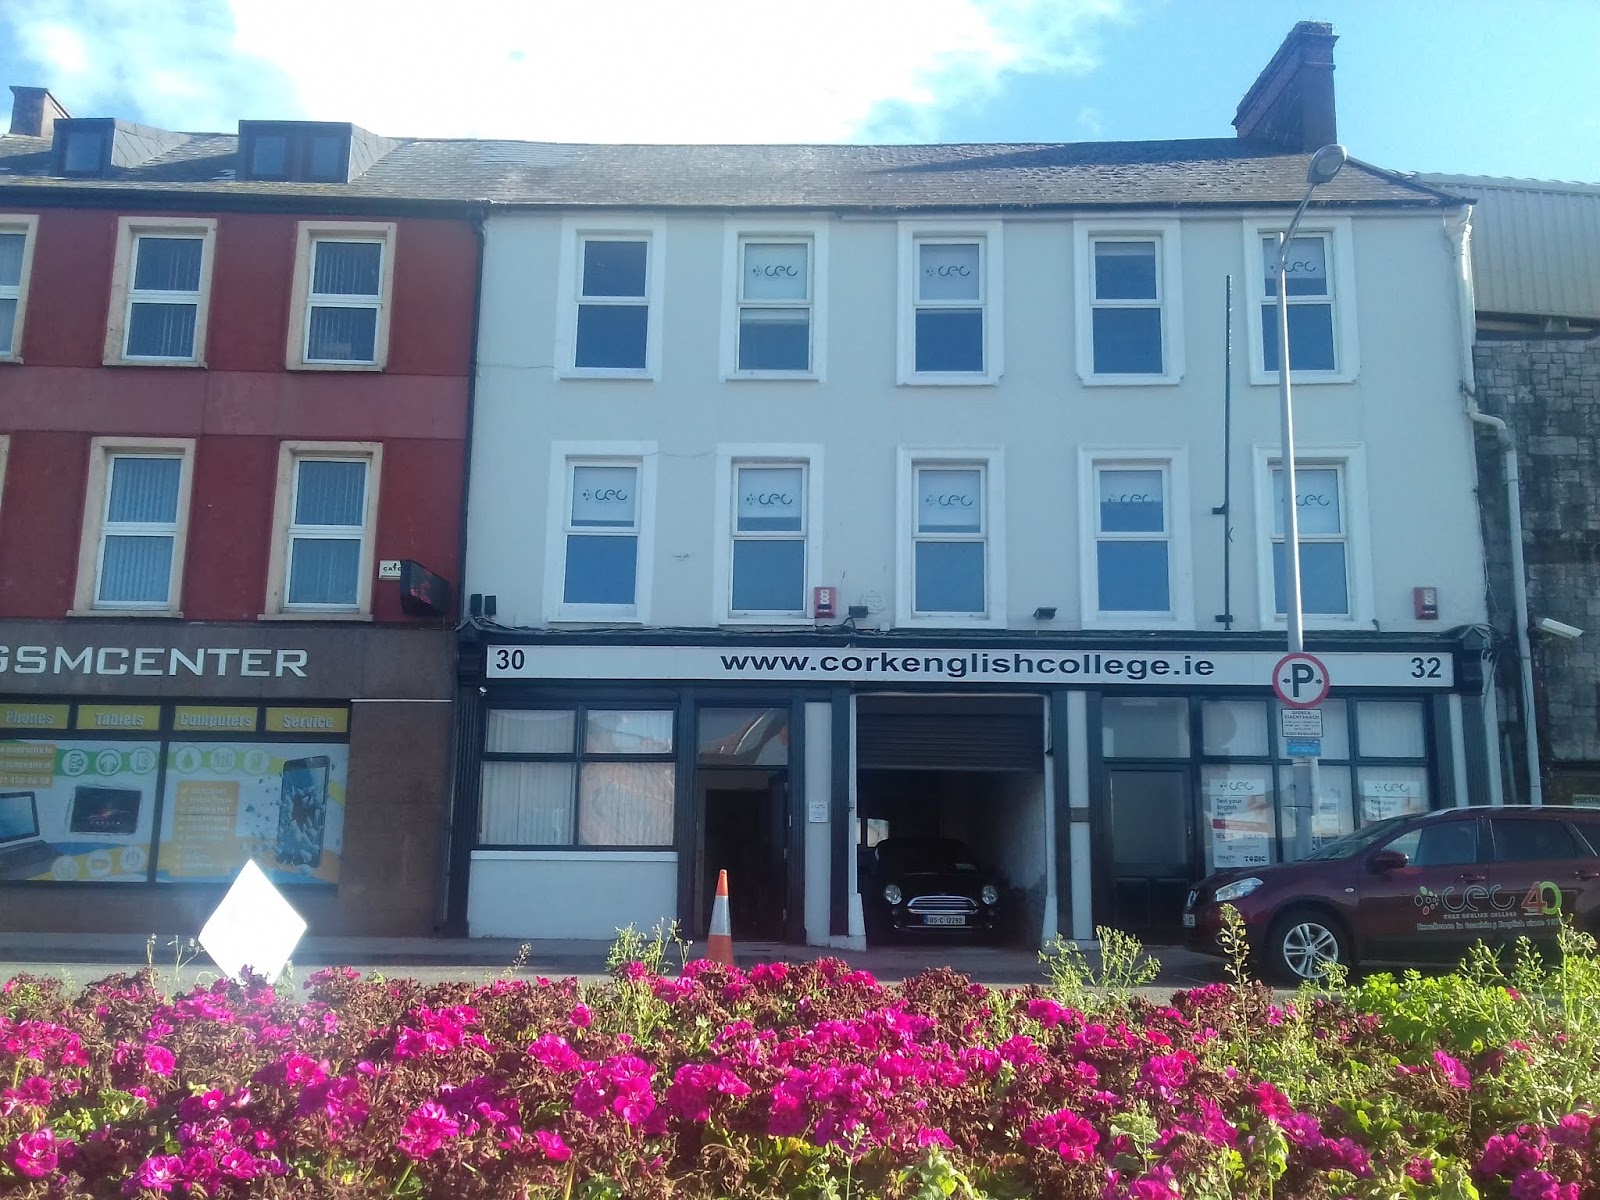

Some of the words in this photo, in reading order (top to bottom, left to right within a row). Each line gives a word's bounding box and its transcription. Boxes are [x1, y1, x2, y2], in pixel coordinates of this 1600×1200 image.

[495, 649, 525, 671] 30
[720, 653, 1215, 679] www.corkenglishcollege.ie
[1410, 656, 1442, 678] 32
[1291, 663, 1315, 698] P
[5, 711, 54, 725] Phones
[95, 712, 145, 726] Tablets
[180, 712, 253, 728] Computers
[283, 714, 334, 729] Service
[1520, 881, 1563, 915] 40
